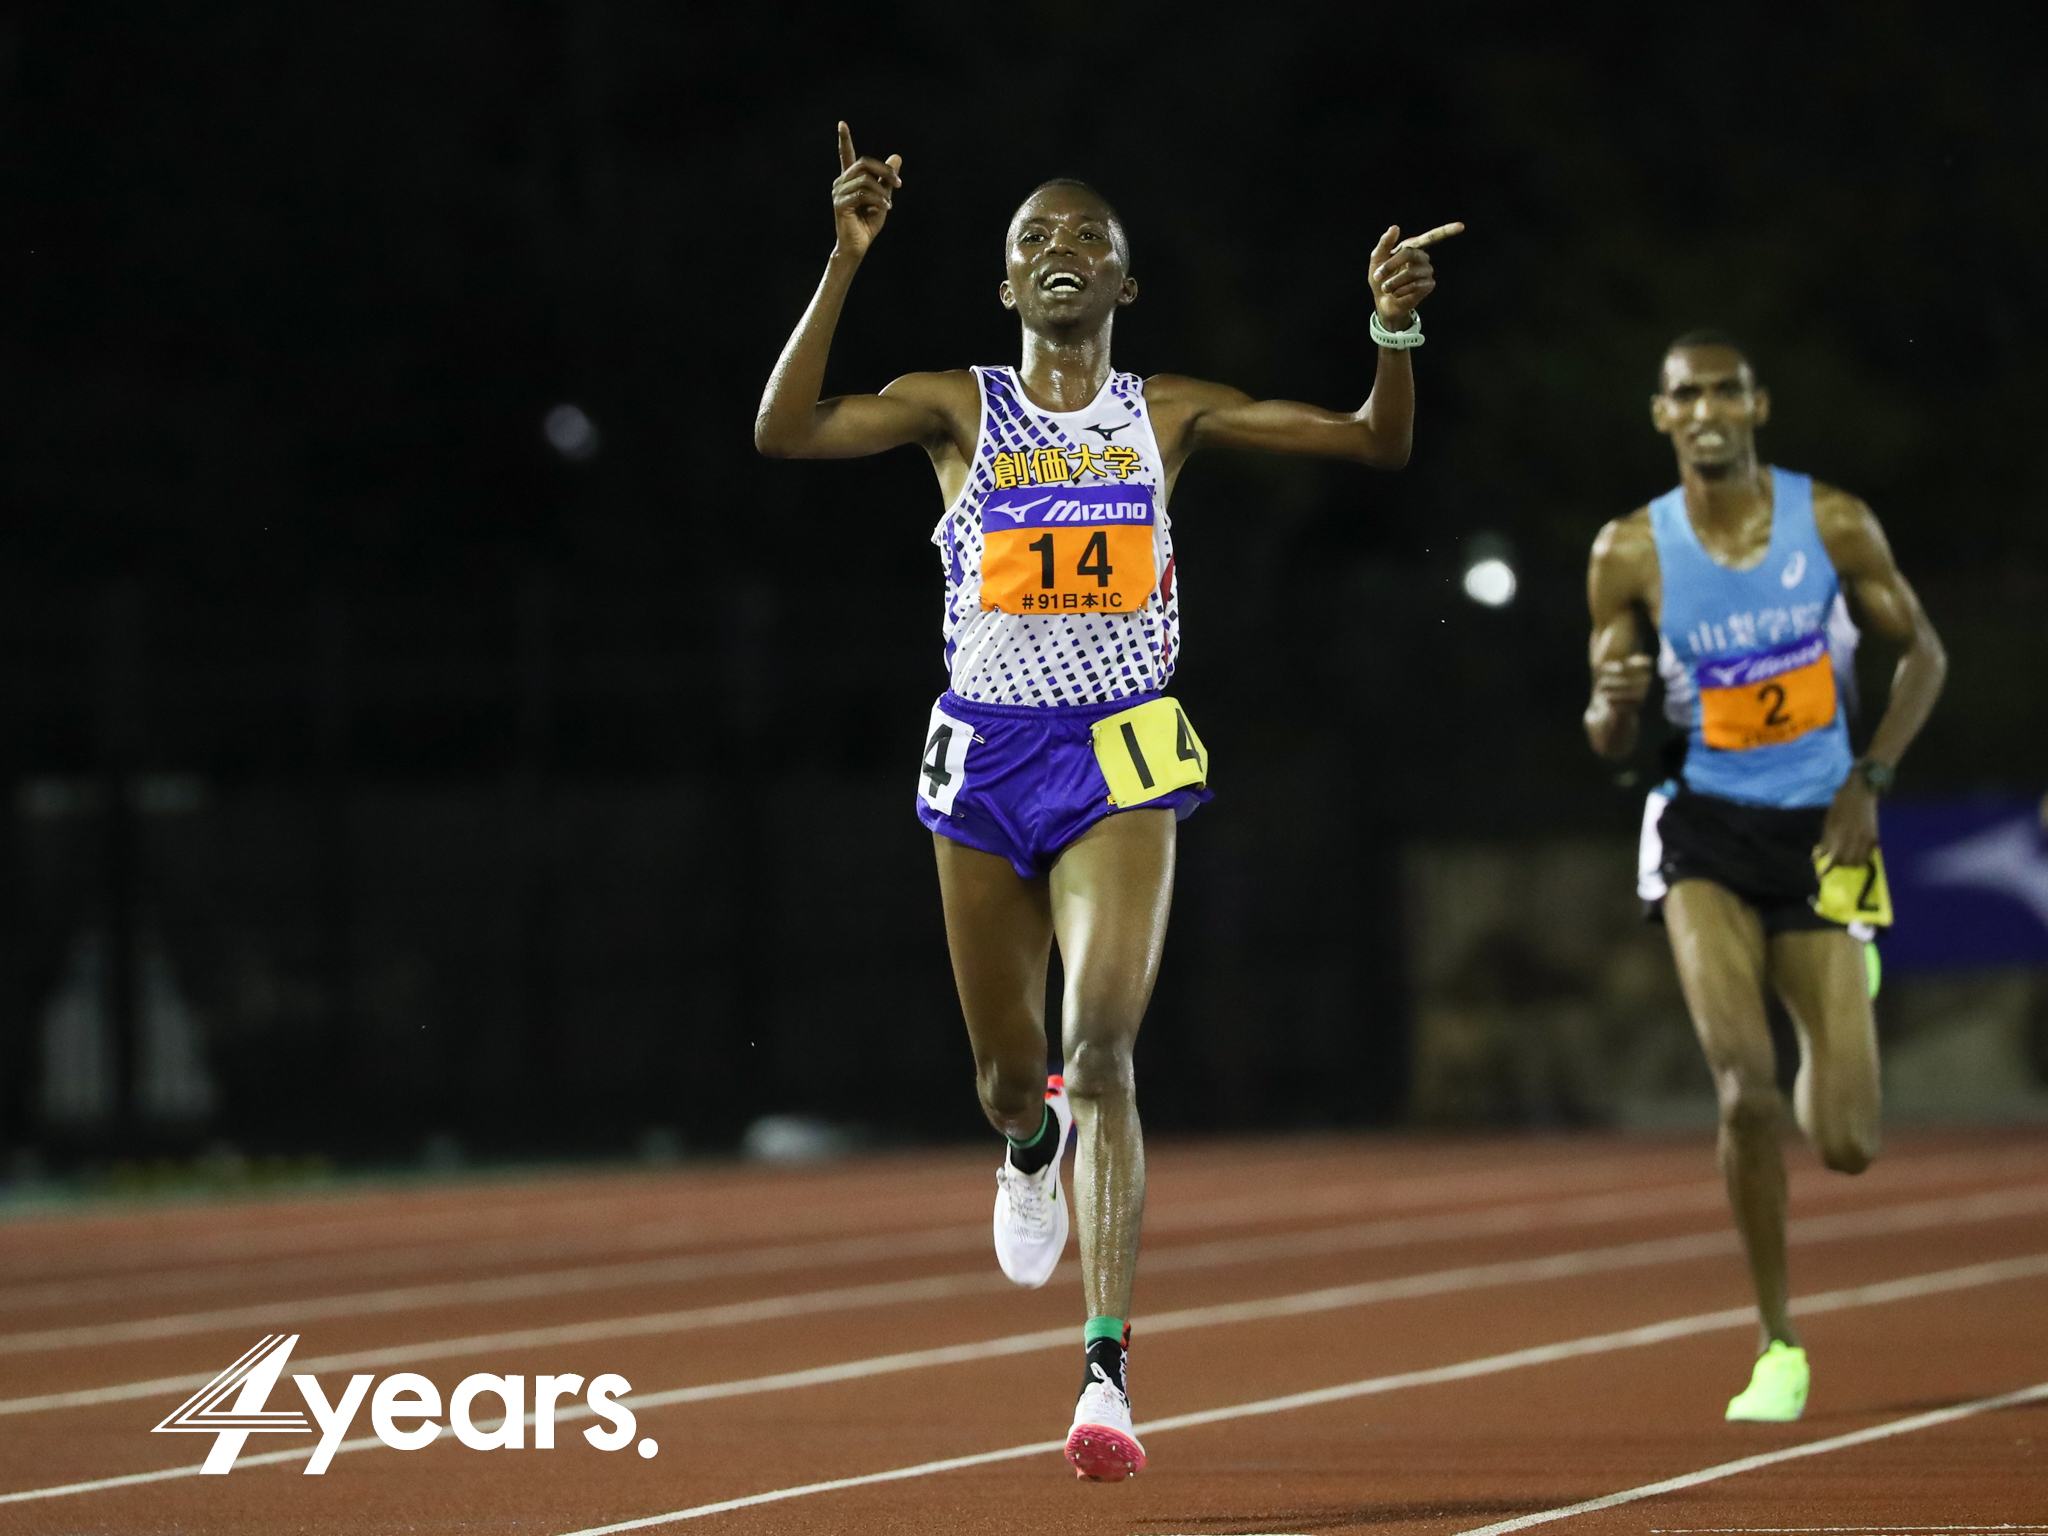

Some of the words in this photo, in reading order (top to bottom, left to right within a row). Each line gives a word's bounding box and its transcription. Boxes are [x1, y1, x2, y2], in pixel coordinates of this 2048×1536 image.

[992, 444, 1141, 489] 創価大学
[1029, 531, 1113, 589] 14
[1758, 683, 1791, 727] 2
[1120, 708, 1203, 789] 14
[1855, 859, 1880, 912] 2
